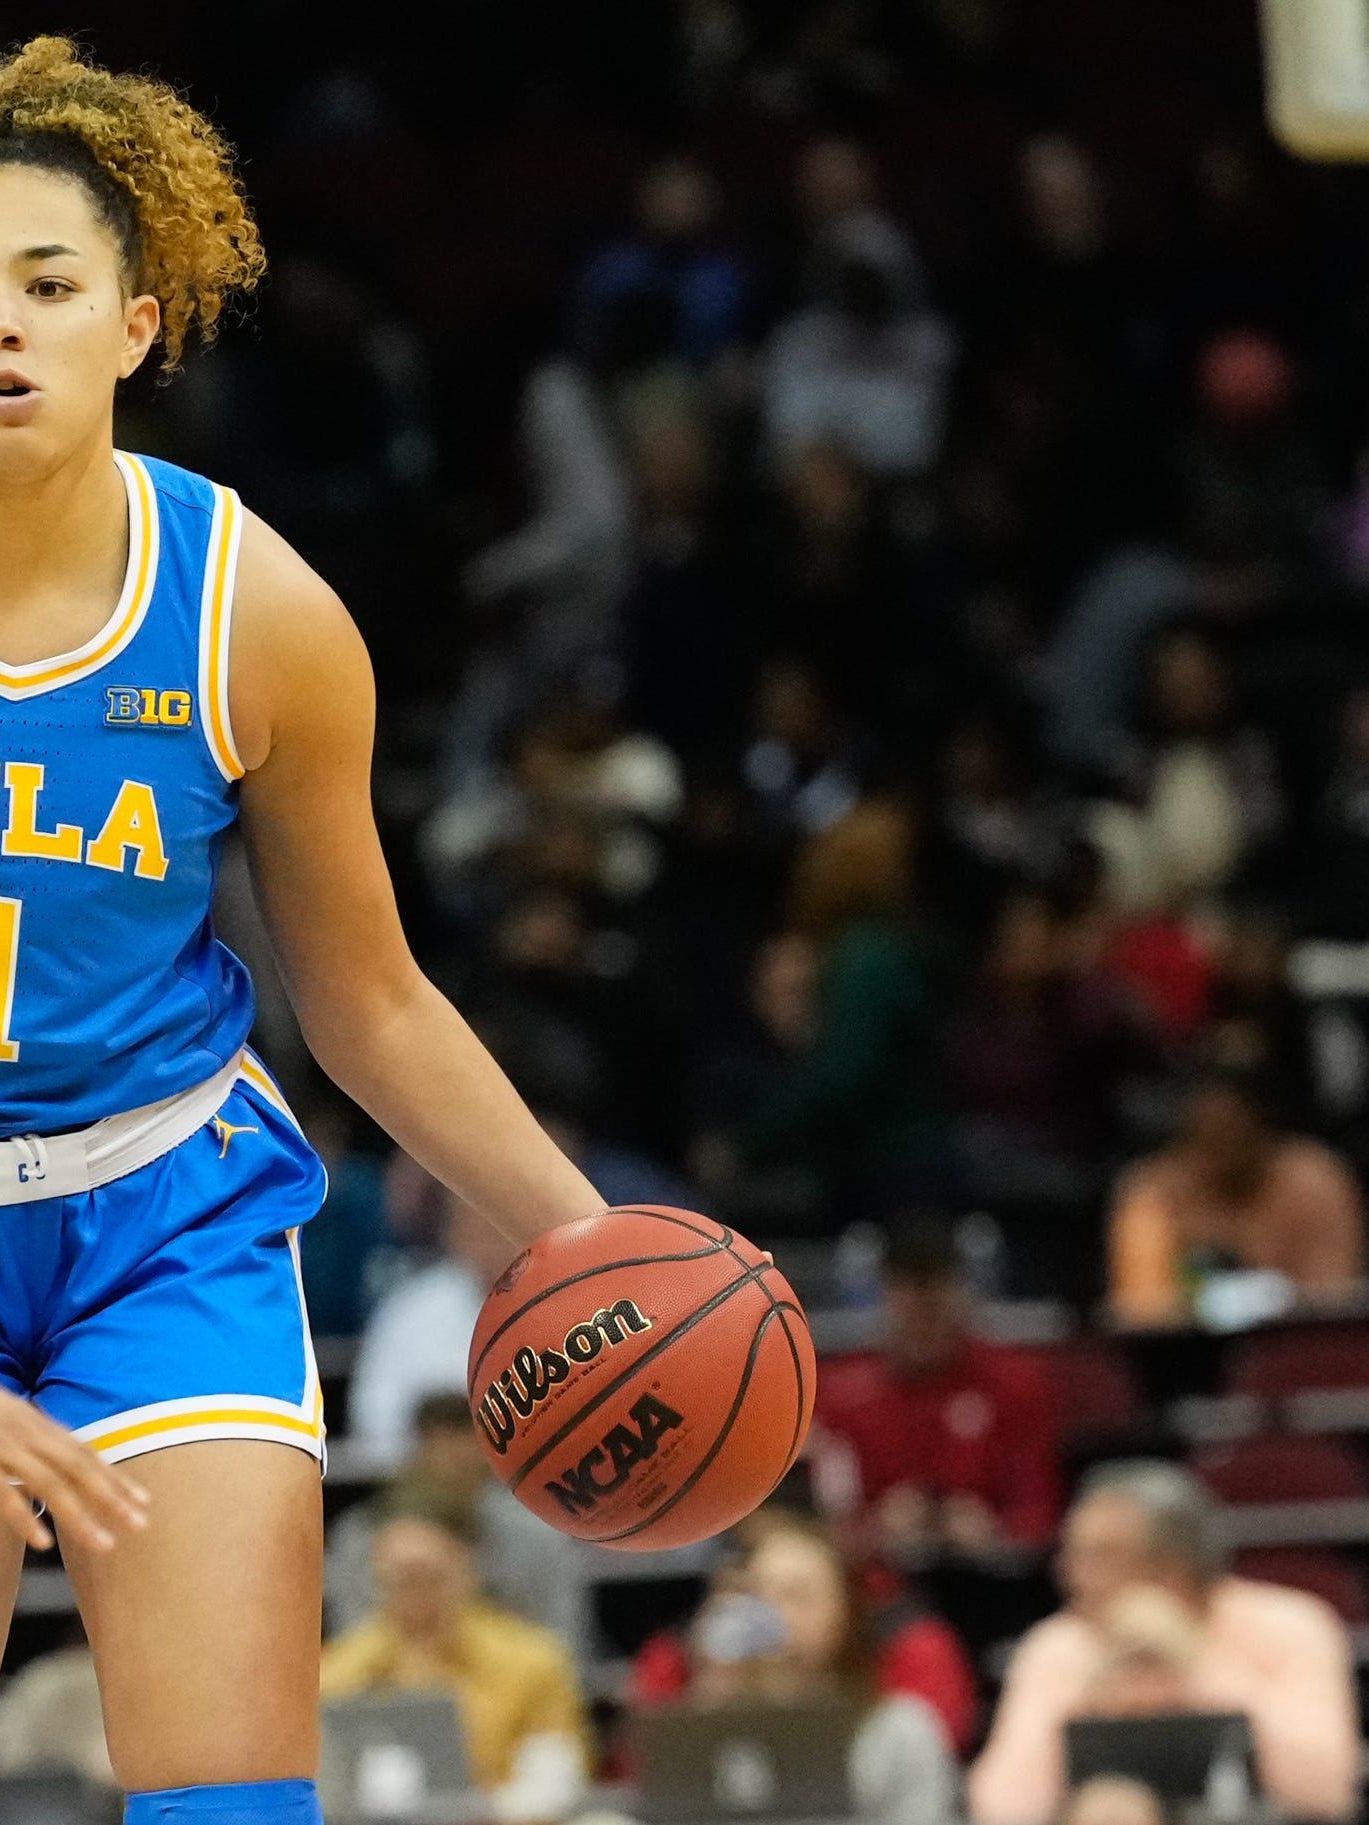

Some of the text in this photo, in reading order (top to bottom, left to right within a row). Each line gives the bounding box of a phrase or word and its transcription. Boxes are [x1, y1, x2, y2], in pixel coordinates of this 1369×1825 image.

[478, 1298, 652, 1455] Wilson
[553, 1376, 581, 1401] GAME
[580, 1356, 607, 1377] BALL
[544, 1391, 685, 1518] NCAA
